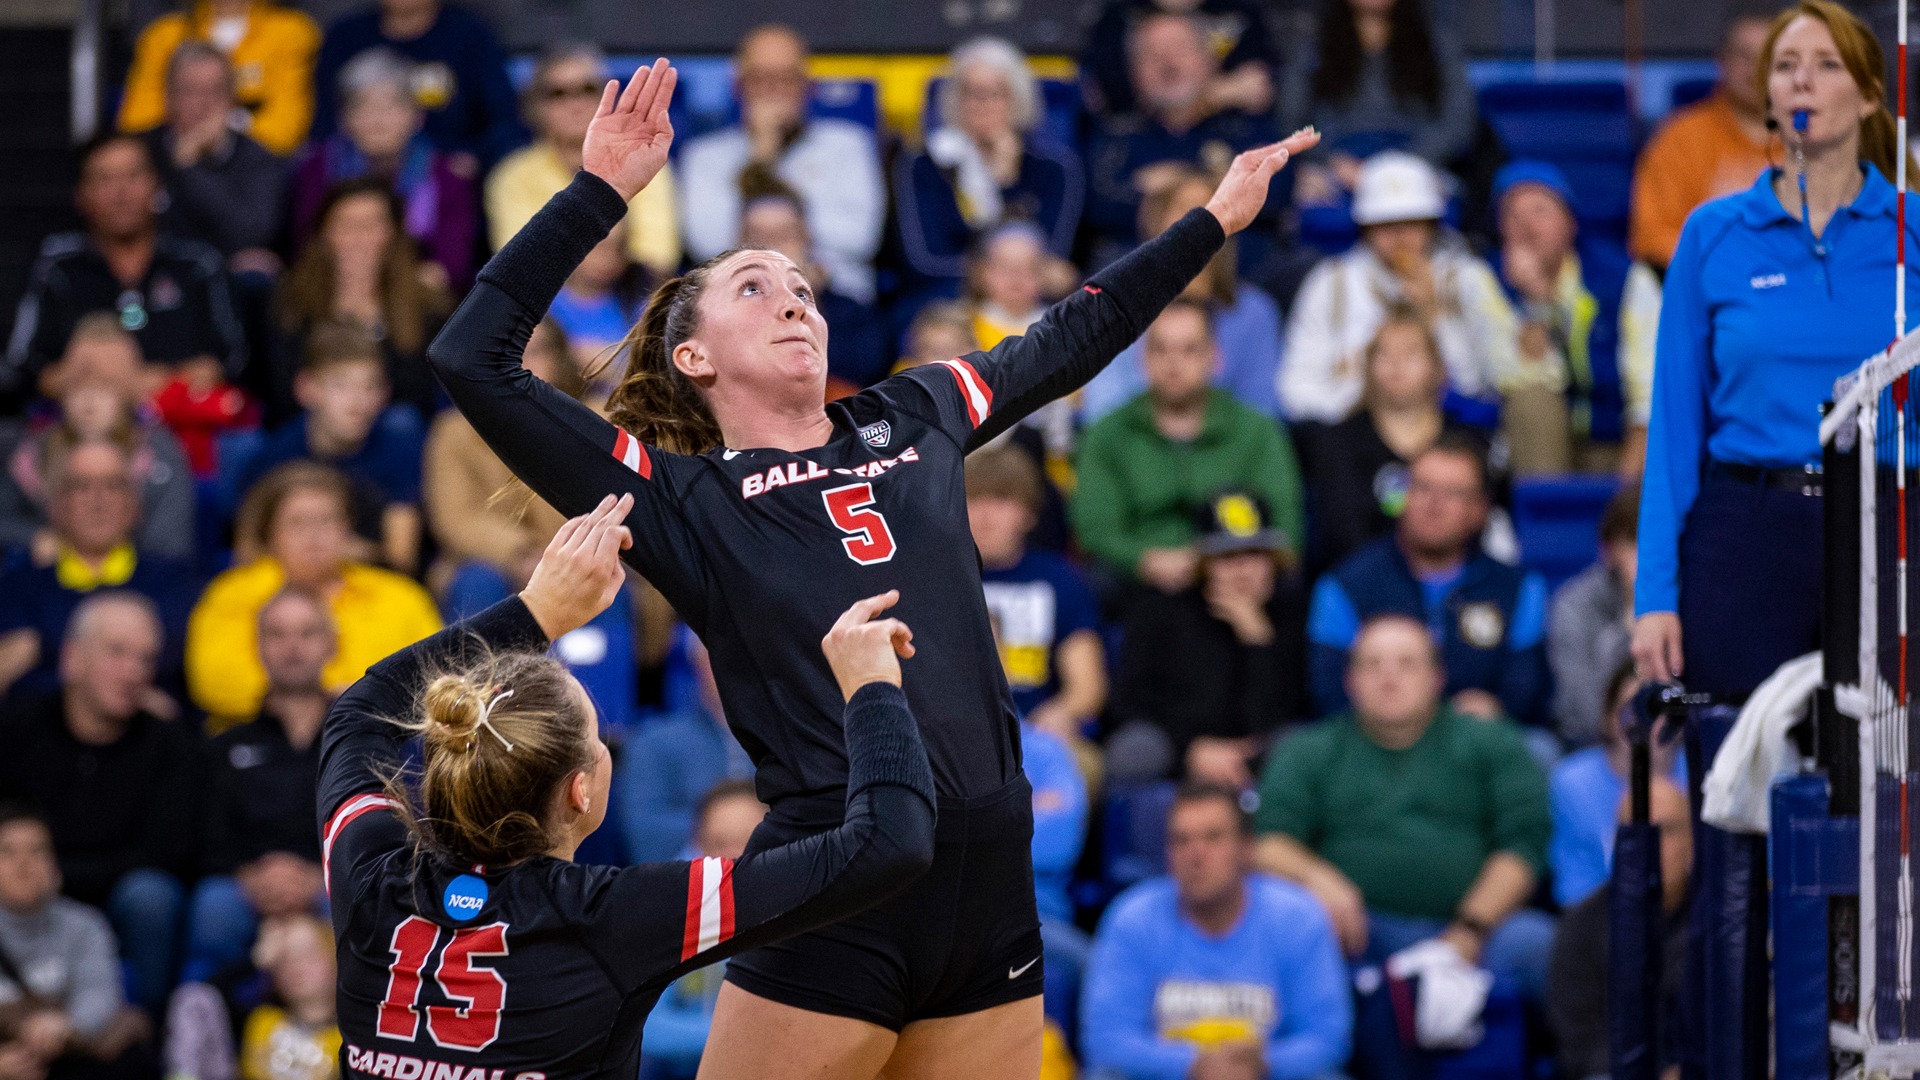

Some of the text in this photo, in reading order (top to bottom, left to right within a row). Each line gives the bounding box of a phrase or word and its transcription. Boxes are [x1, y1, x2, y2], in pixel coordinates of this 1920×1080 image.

[742, 459, 829, 499] BALL
[821, 482, 897, 566] 5
[448, 894, 484, 910] NCAA
[376, 914, 510, 1053] 15
